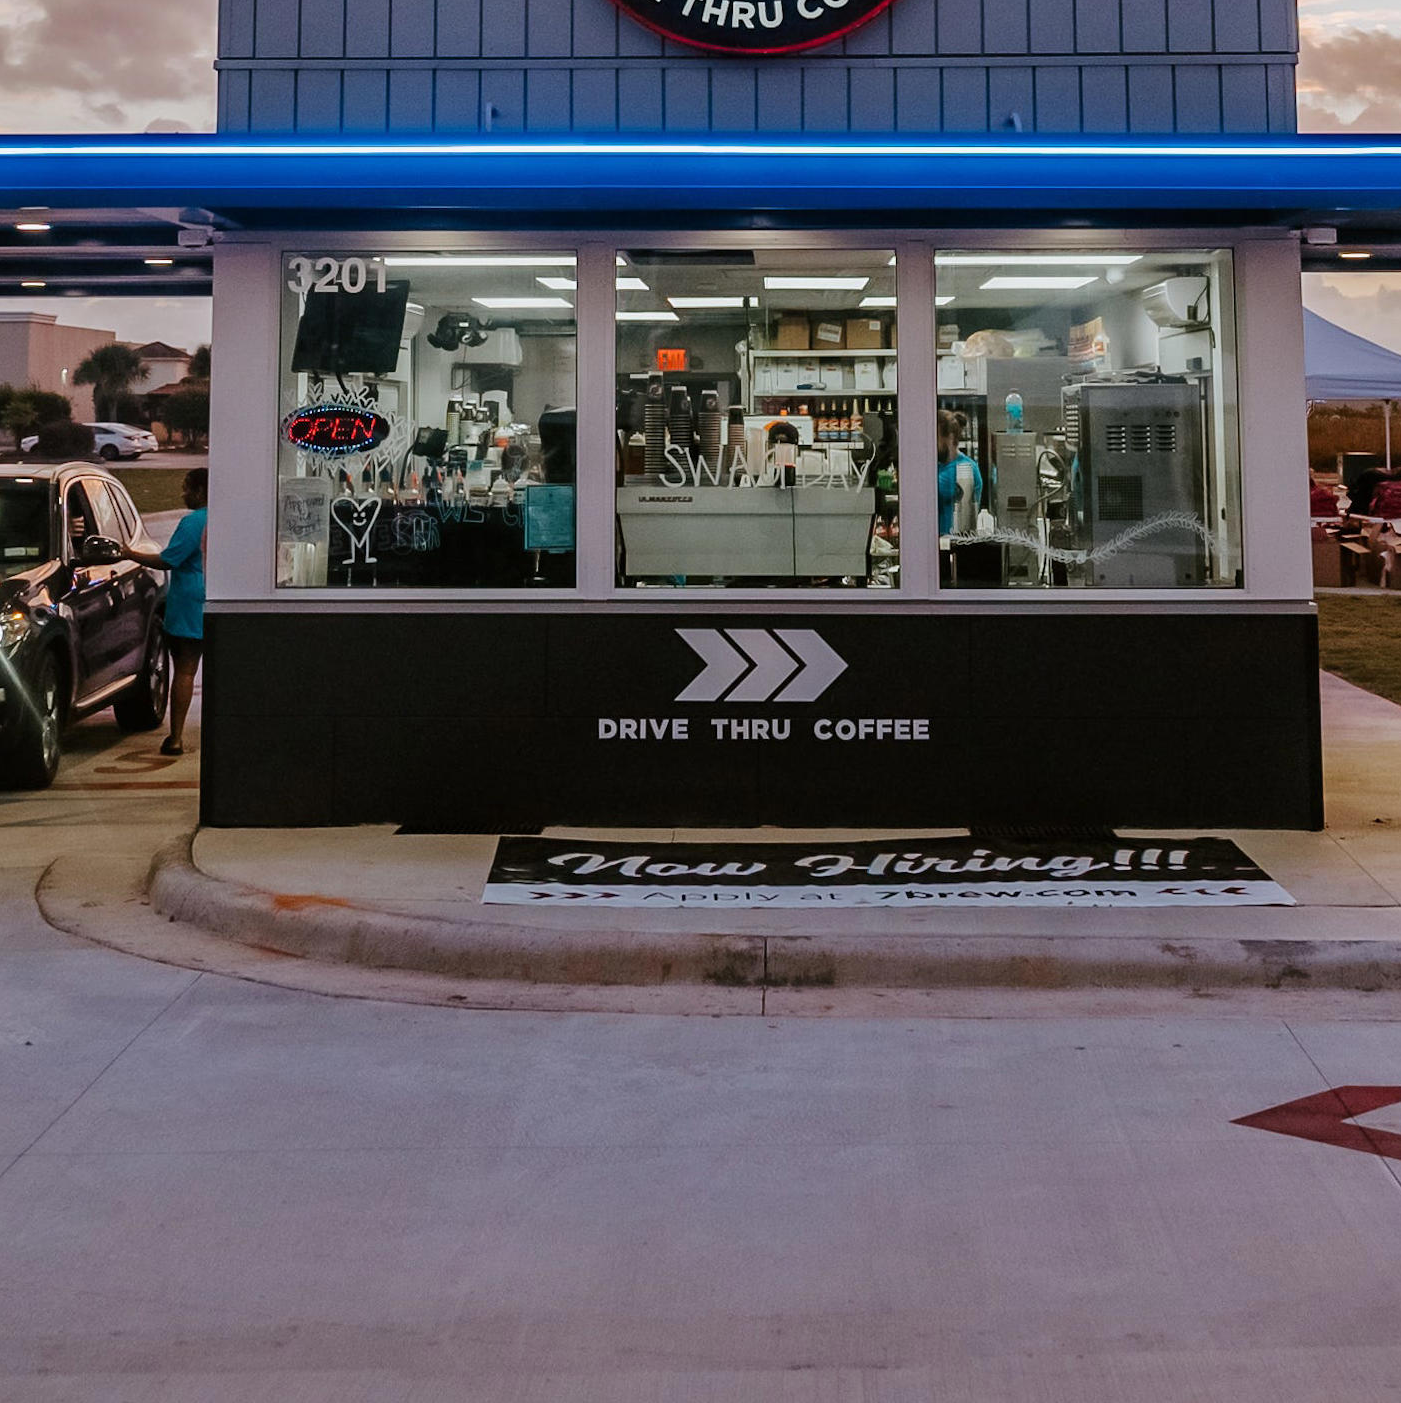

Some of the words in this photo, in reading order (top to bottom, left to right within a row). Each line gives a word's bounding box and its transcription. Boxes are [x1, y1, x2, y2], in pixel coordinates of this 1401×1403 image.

[287, 257, 386, 293] 3201
[288, 417, 377, 442] OPEN
[598, 718, 689, 740] DRIVE
[711, 718, 792, 740] THRU
[813, 718, 930, 741] COFFEE
[547, 852, 767, 878] Now
[794, 848, 1190, 878] Hiring!!!
[642, 891, 780, 902] Apply
[800, 892, 843, 901] at
[874, 888, 1138, 900] 7brew.com
